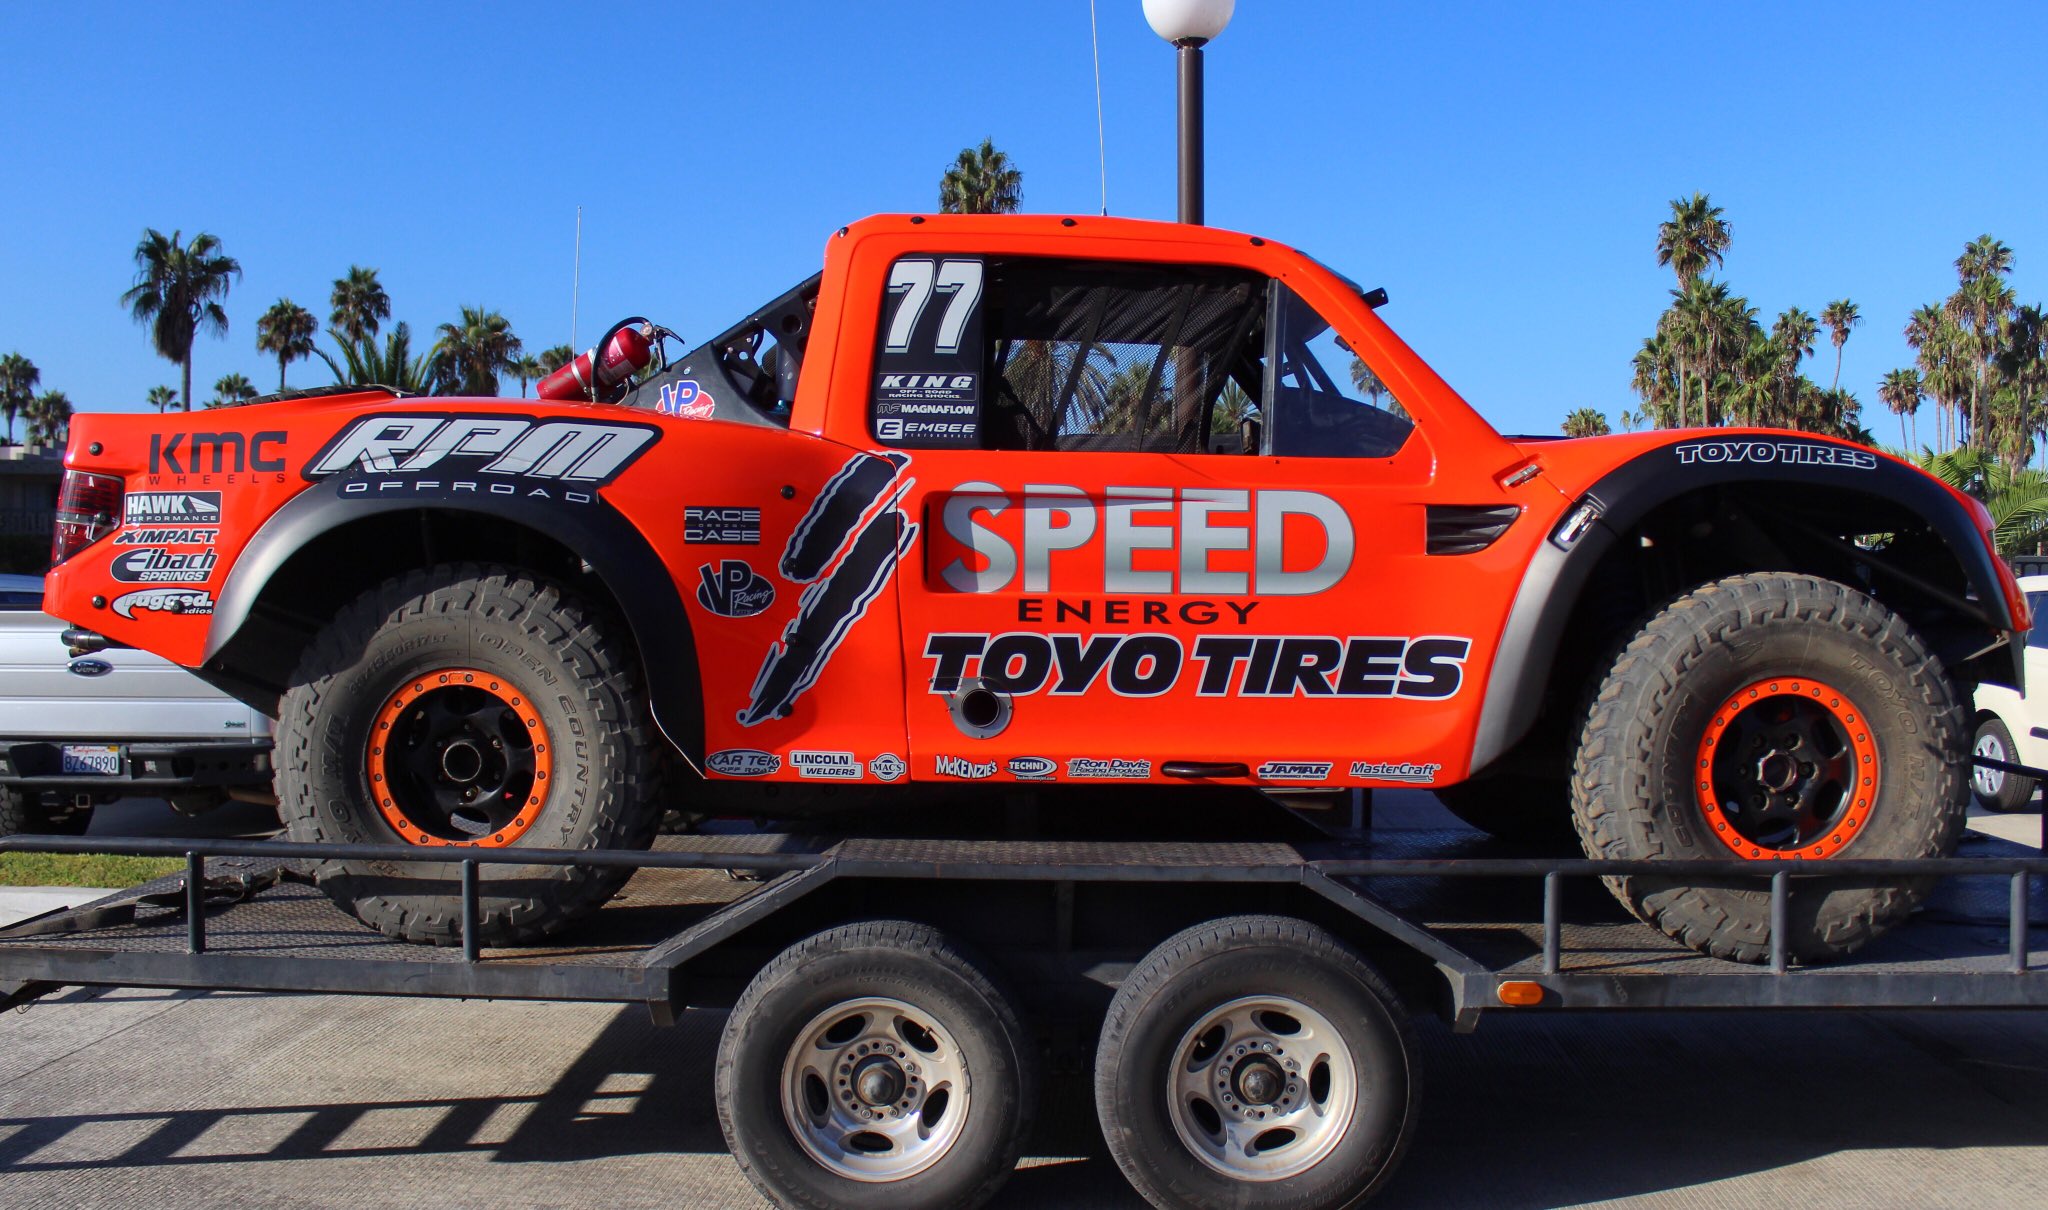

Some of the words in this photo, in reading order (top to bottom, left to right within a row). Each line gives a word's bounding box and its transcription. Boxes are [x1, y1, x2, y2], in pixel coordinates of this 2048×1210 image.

[885, 259, 983, 354] 77
[880, 376, 973, 388] KING
[901, 405, 975, 415] MAGNAFLOW
[904, 423, 977, 433] EMBEE
[310, 417, 656, 482] RPM
[1676, 442, 1777, 465] TOYO
[1777, 443, 1877, 470] TIRES
[149, 473, 286, 485] WHEELS
[345, 480, 591, 505] OFFROAD
[127, 495, 188, 515] HAWK
[684, 509, 760, 521] RACE
[684, 530, 760, 541] CASE
[941, 481, 1356, 596] SPEED
[111, 548, 219, 574] Eibach
[139, 571, 206, 581] SPRINGS
[698, 560, 753, 617] VP
[734, 589, 772, 609] Racing
[1017, 598, 1261, 625] ENERGY
[922, 632, 1184, 697] TOYO
[1188, 635, 1473, 701] TIRES
[64, 756, 118, 771] 8Z67890
[707, 754, 743, 766] KAR
[748, 755, 780, 768] TEK
[793, 754, 849, 765] LINCOLN
[1009, 761, 1044, 770] TECHNI
[1077, 760, 1108, 768] Ron
[1111, 760, 1150, 768] Davis
[558, 694, 590, 847] COUNTRY
[806, 767, 856, 776] WELDERS
[1258, 763, 1332, 775] JAMAR
[1351, 762, 1435, 775] MasterCraft
